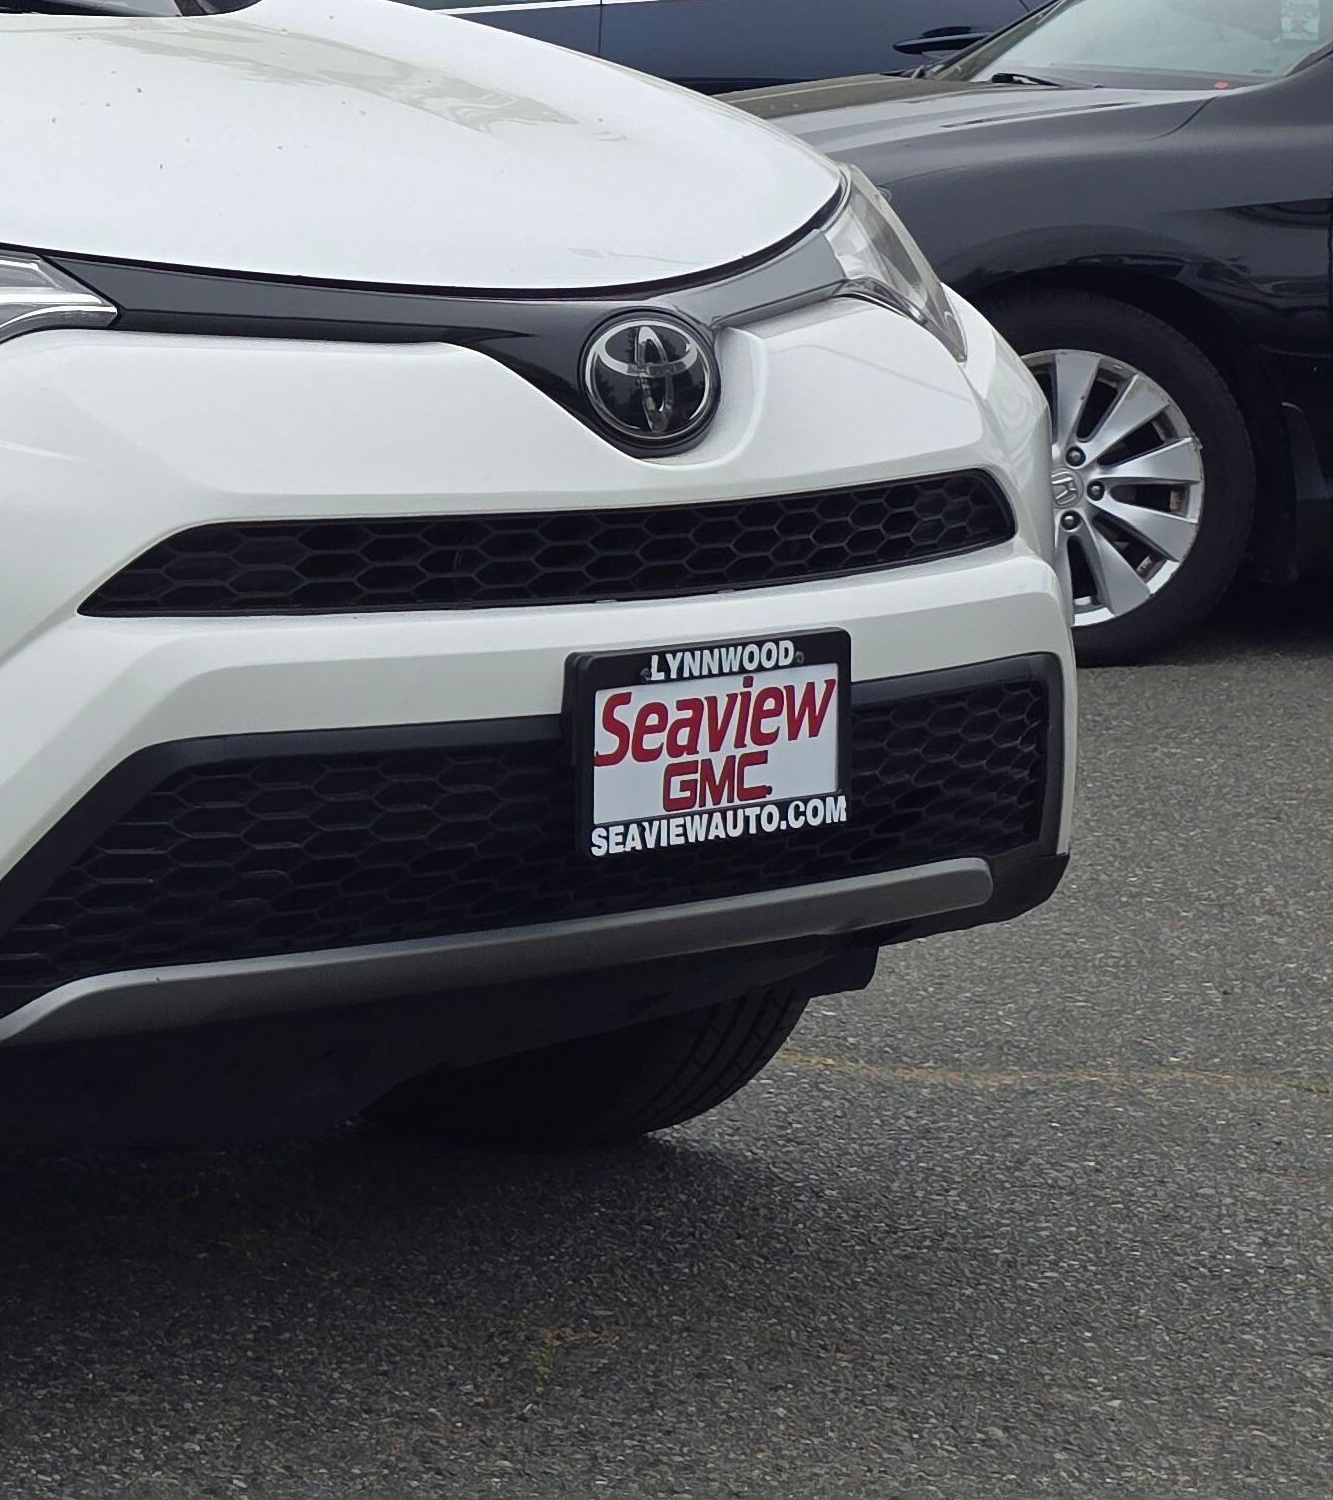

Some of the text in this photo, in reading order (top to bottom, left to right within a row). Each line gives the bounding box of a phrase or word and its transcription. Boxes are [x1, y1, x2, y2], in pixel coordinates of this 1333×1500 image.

[650, 640, 795, 681] LYNNWOOD
[593, 676, 836, 767] Seaview
[663, 750, 770, 812] GMC
[591, 796, 847, 857] SEAVIEWAUTO.COM
